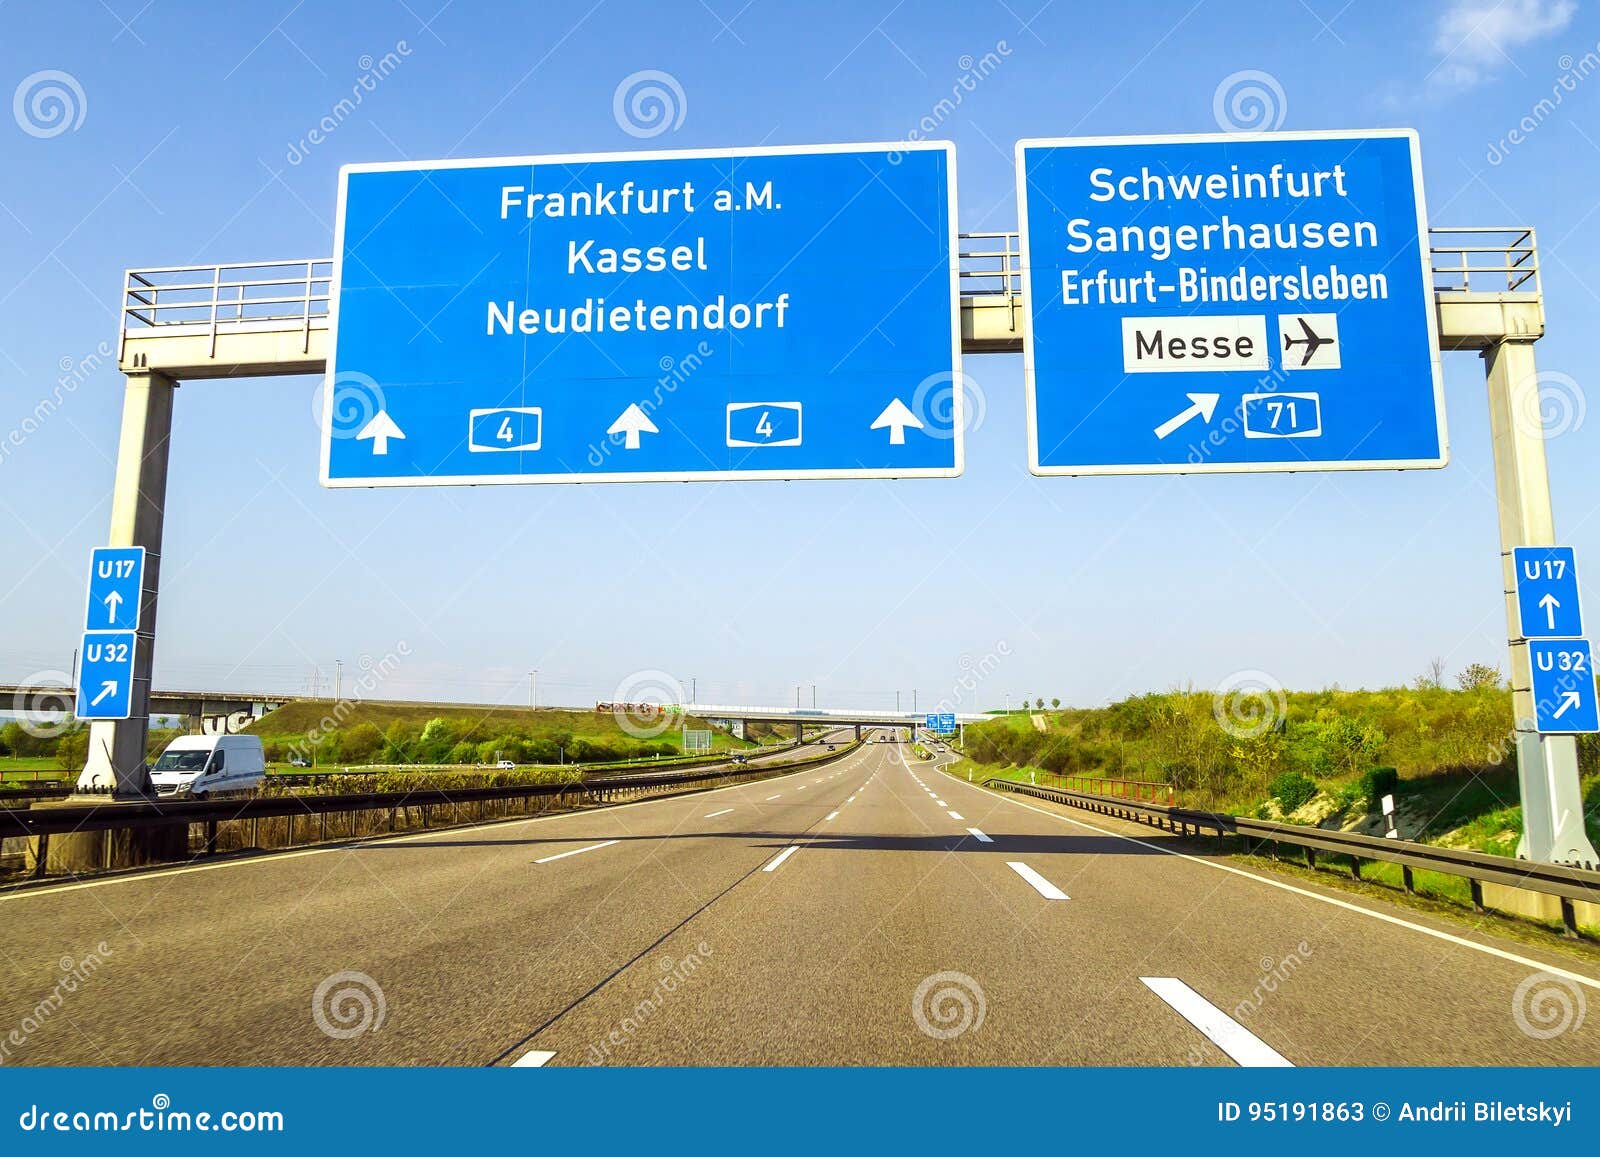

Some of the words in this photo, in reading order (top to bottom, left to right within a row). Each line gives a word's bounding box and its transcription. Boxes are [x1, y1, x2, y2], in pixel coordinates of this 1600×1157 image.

[501, 182, 695, 219] Frankfurt
[713, 181, 782, 211] a.M.
[1089, 164, 1348, 202] Schweinfurt
[568, 237, 708, 274] Kassel
[1067, 215, 1378, 261] Sangerhausen
[1062, 264, 1388, 305] Erfurt-Bindersleben
[487, 293, 790, 336] Neudietendorf
[1135, 330, 1254, 360] Messe
[496, 417, 514, 443] 4
[755, 411, 773, 438] 4
[1267, 402, 1297, 429] 71
